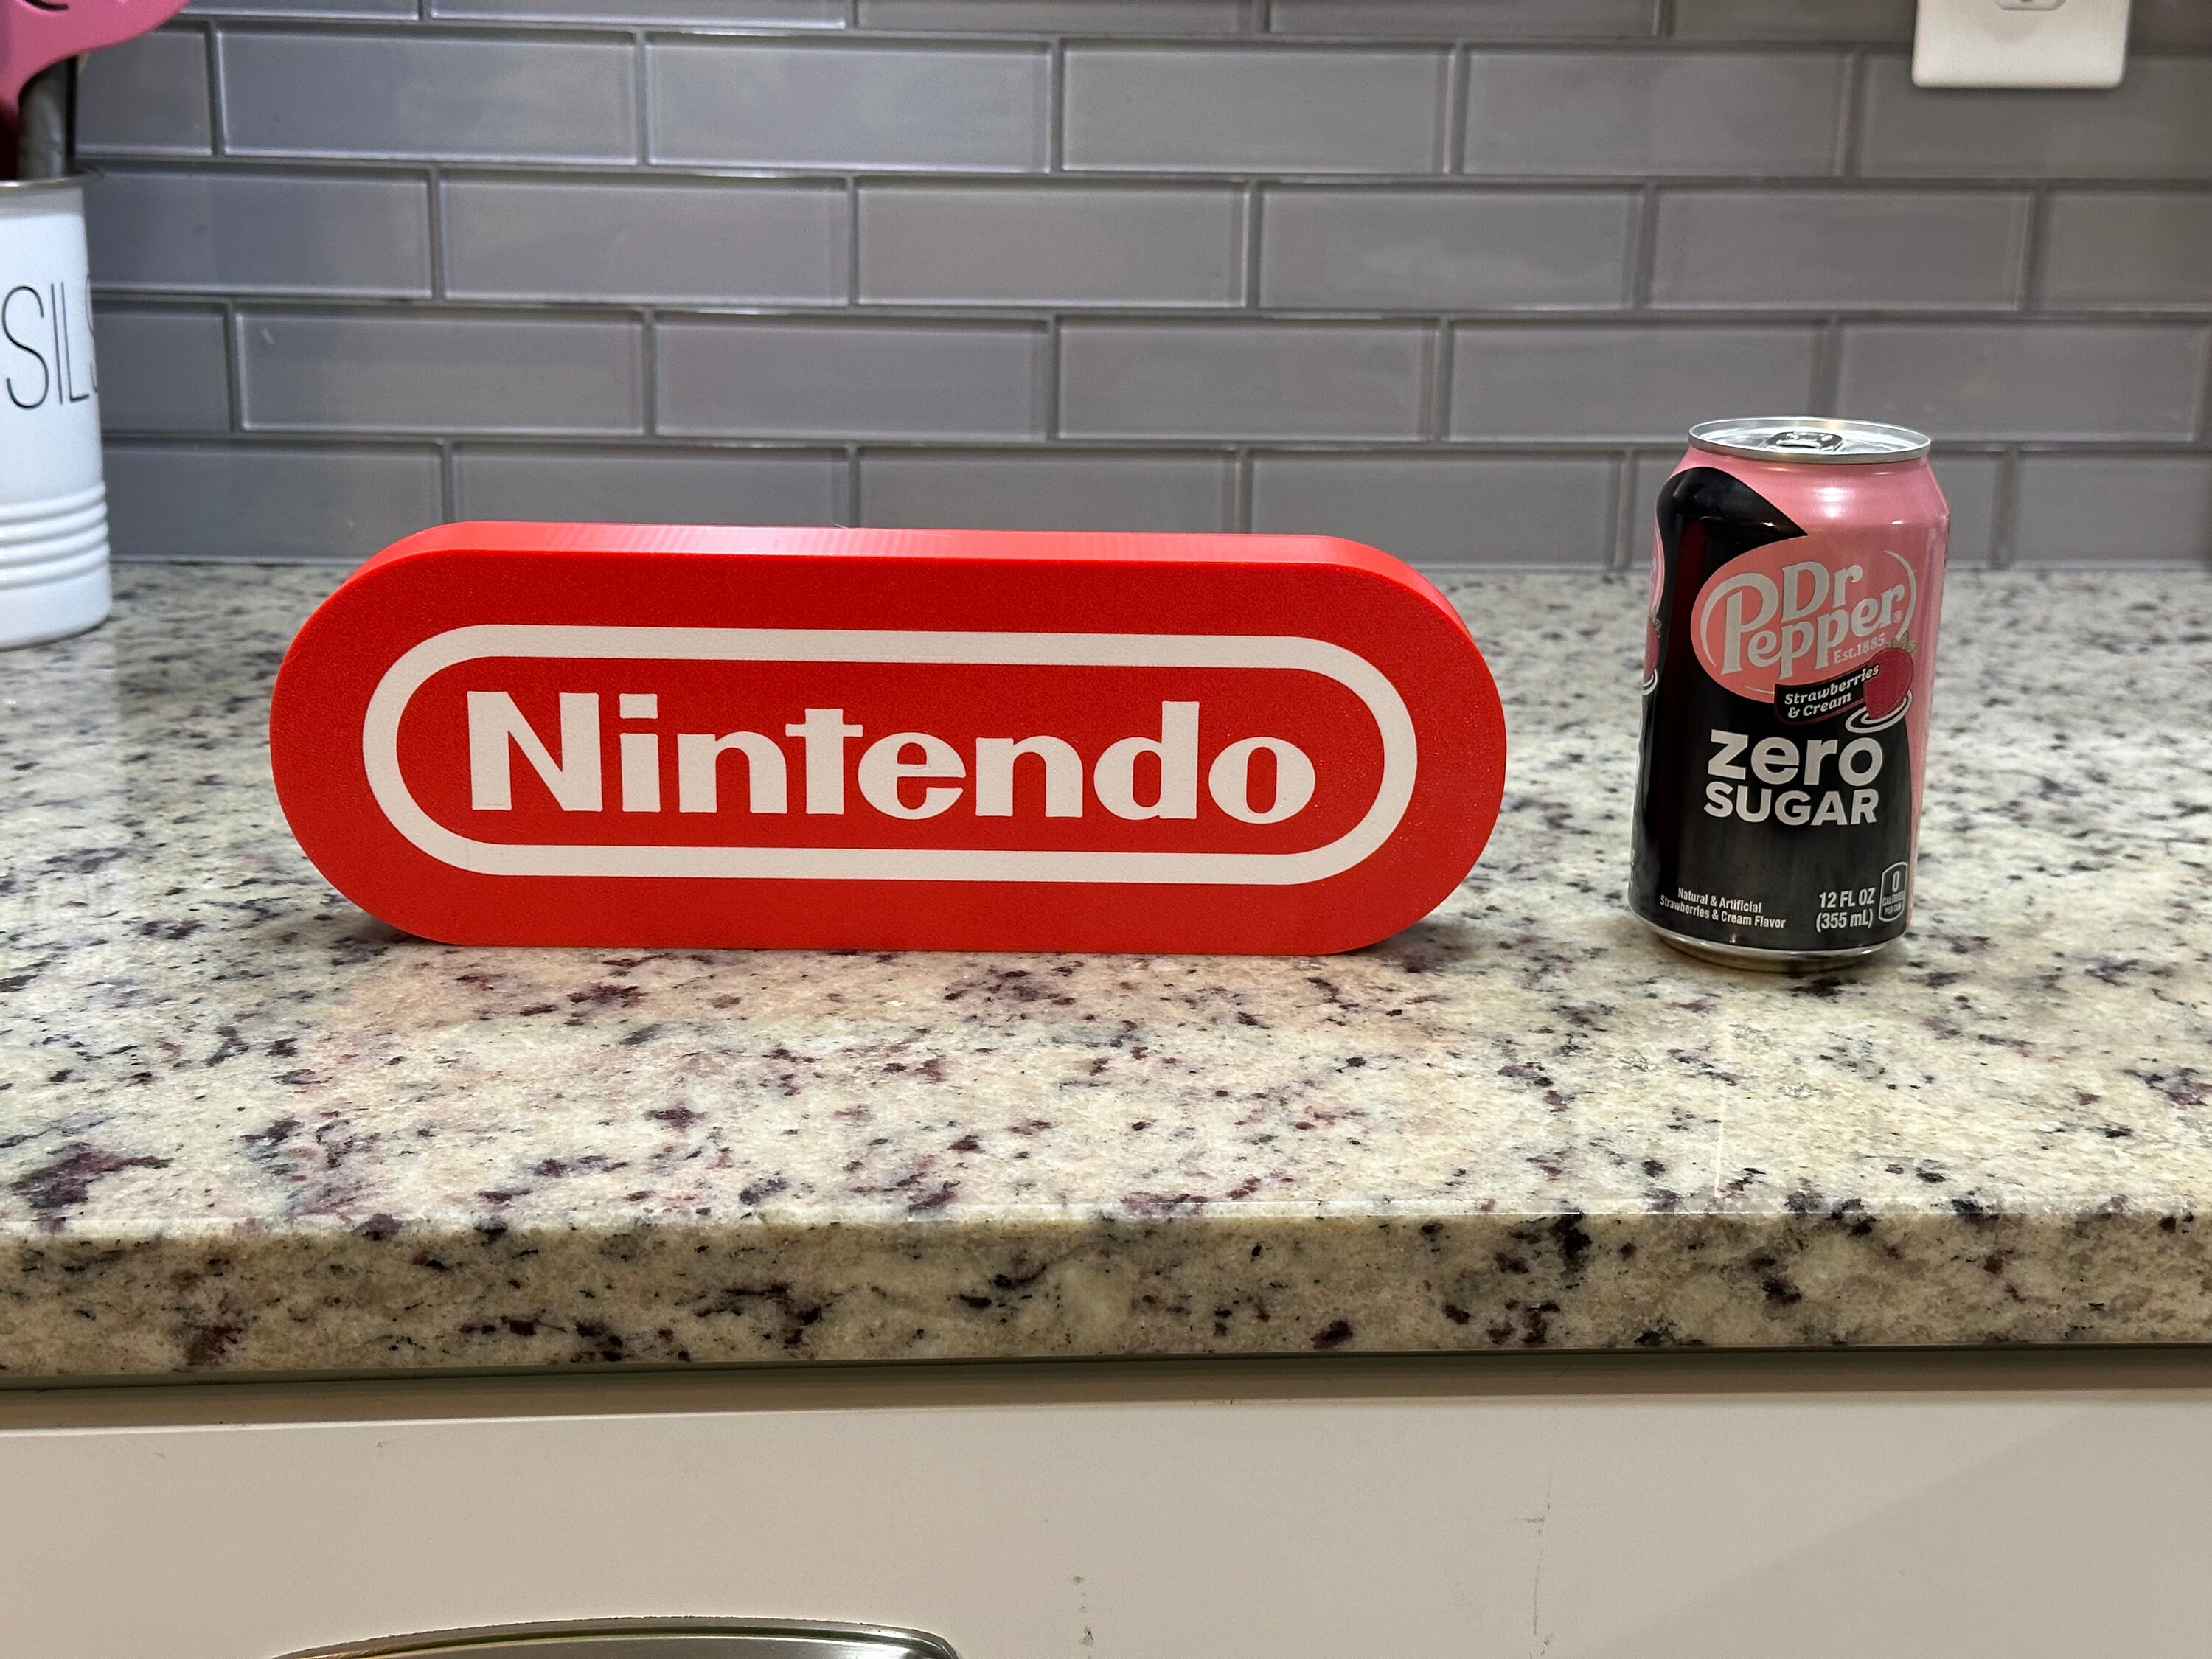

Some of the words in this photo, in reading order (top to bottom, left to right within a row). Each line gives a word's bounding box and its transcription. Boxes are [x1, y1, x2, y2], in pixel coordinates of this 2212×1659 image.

[1, 281, 97, 410] SIL
[1781, 561, 1863, 623] Dr
[1701, 572, 1905, 679] Pepper
[1784, 664, 1879, 705] Strawberries
[1787, 706, 1801, 719] &
[1802, 692, 1851, 717] Cream
[466, 689, 1316, 825] Nintendo
[1707, 728, 1883, 787] zero
[1703, 781, 1879, 826] SUGAR
[1660, 894, 1710, 919] Strawberries
[1711, 909, 1719, 921] &
[1721, 910, 1752, 926] Cream
[1754, 915, 1786, 929] Flavor
[1677, 887, 1709, 905] Natural
[1710, 895, 1717, 907] &
[1719, 897, 1762, 914] Artificial
[1819, 891, 1837, 908] 12
[1839, 890, 1856, 908] FL
[1858, 887, 1876, 905] OZ
[1816, 912, 1848, 933] (355
[1849, 908, 1873, 929] mL)
